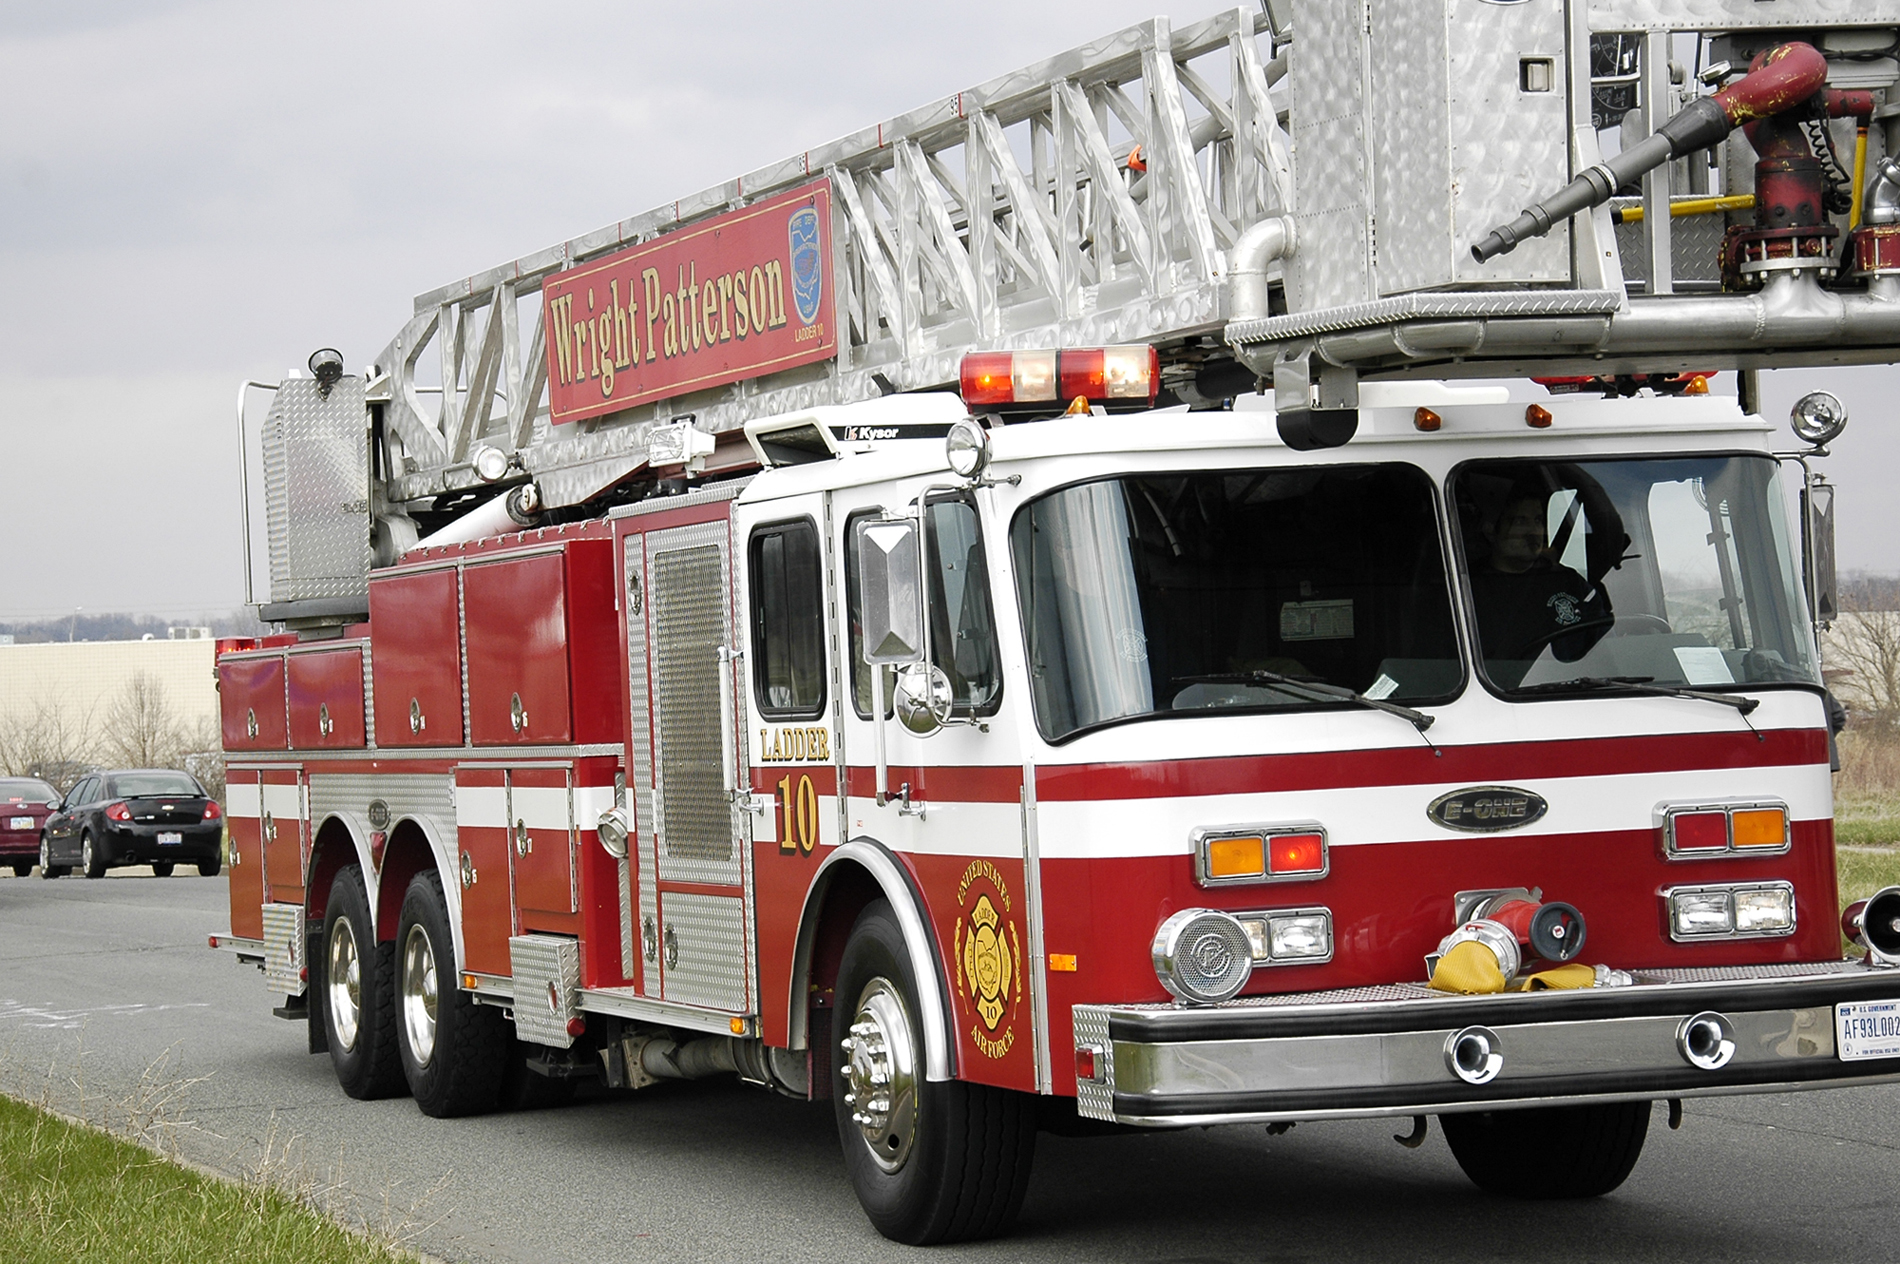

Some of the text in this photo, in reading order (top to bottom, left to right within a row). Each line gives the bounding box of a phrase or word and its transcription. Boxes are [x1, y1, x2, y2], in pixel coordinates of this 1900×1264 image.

[550, 259, 788, 397] Wright Patterson
[794, 322, 824, 342] LADDER 10
[859, 425, 899, 440] Kysor
[760, 727, 829, 761] LADDER
[777, 774, 817, 855] 10
[1443, 798, 1529, 820] E-ONE
[958, 860, 1011, 912] UNITED STATES
[974, 907, 995, 924] LADDER
[986, 1006, 997, 1019] 10
[1868, 1004, 1897, 1012] GOVERNMENT
[971, 1025, 1015, 1059] AIR FORCE
